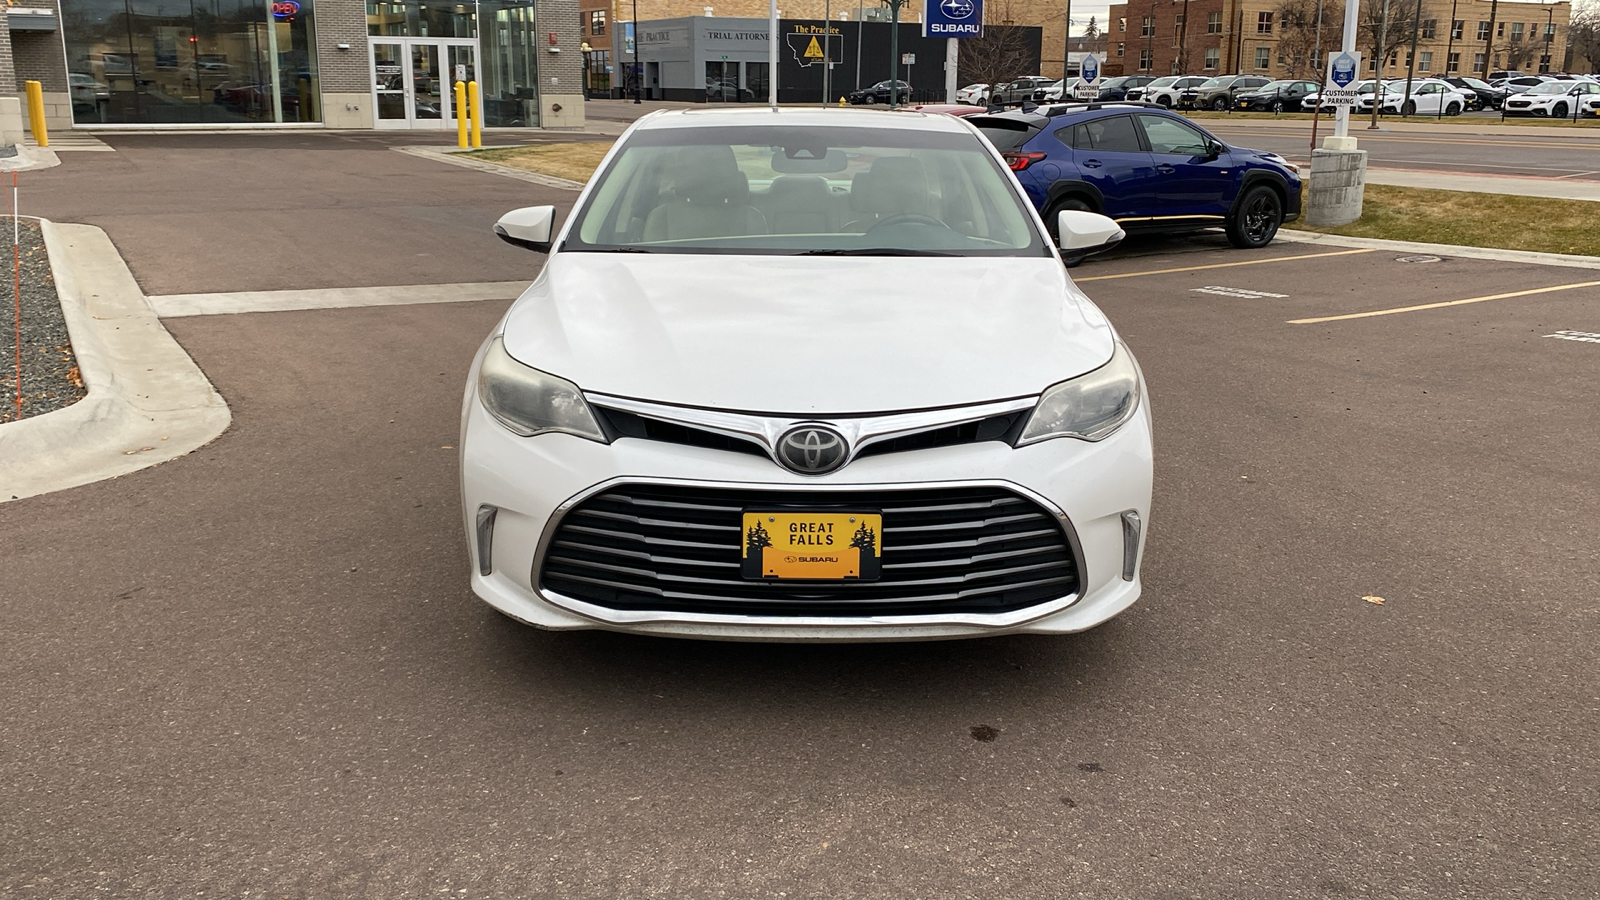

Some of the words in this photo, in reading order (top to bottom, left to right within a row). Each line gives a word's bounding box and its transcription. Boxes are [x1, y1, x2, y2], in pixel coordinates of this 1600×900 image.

[271, 3, 297, 13] OPEN
[794, 25, 809, 33] The
[810, 25, 840, 34] Pracice
[931, 23, 979, 32] SUBARU
[708, 31, 733, 40] TRIAL
[734, 32, 780, 41] ATTORNES
[789, 522, 834, 532] GREAT
[789, 534, 834, 545] FALLS
